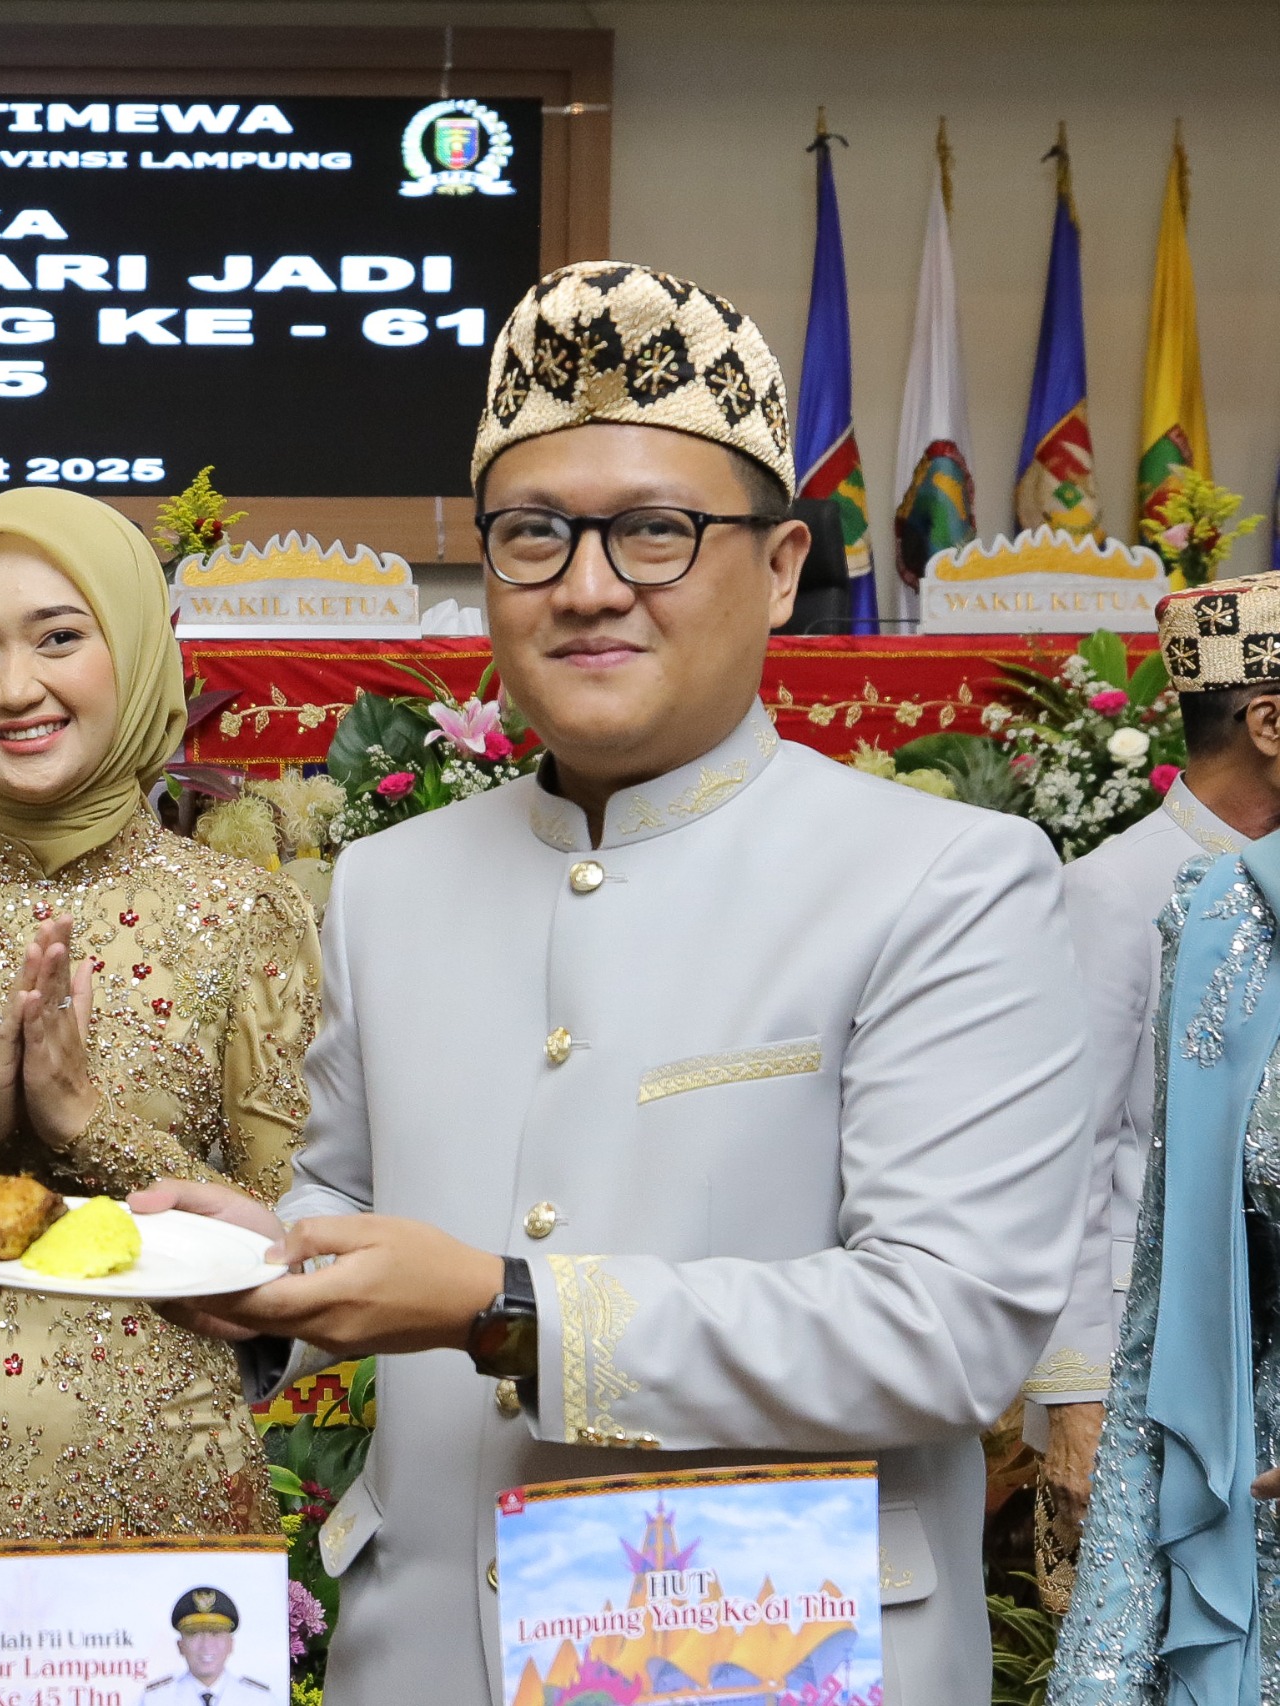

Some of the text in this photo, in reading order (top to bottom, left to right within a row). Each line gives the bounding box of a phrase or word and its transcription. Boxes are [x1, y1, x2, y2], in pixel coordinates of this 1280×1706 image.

[140, 152, 352, 170] LAMPUNG
[188, 255, 452, 292] JADI
[98, 308, 254, 345] KE
[291, 325, 326, 336] -
[362, 308, 486, 346] 61
[26, 458, 165, 482] 2025
[190, 597, 400, 616] WAKIL KETUA
[944, 592, 1150, 612] WAKIL KETUA
[650, 1572, 710, 1597] HUT
[518, 1613, 643, 1642] Lampung
[652, 1605, 715, 1629] Yang
[724, 1599, 759, 1621] Ke
[799, 1595, 857, 1619] Thn
[37, 1628, 62, 1648] Fii
[68, 1627, 134, 1648] Umrik
[24, 1655, 149, 1682] Lampung
[68, 1685, 122, 1706] Thn
